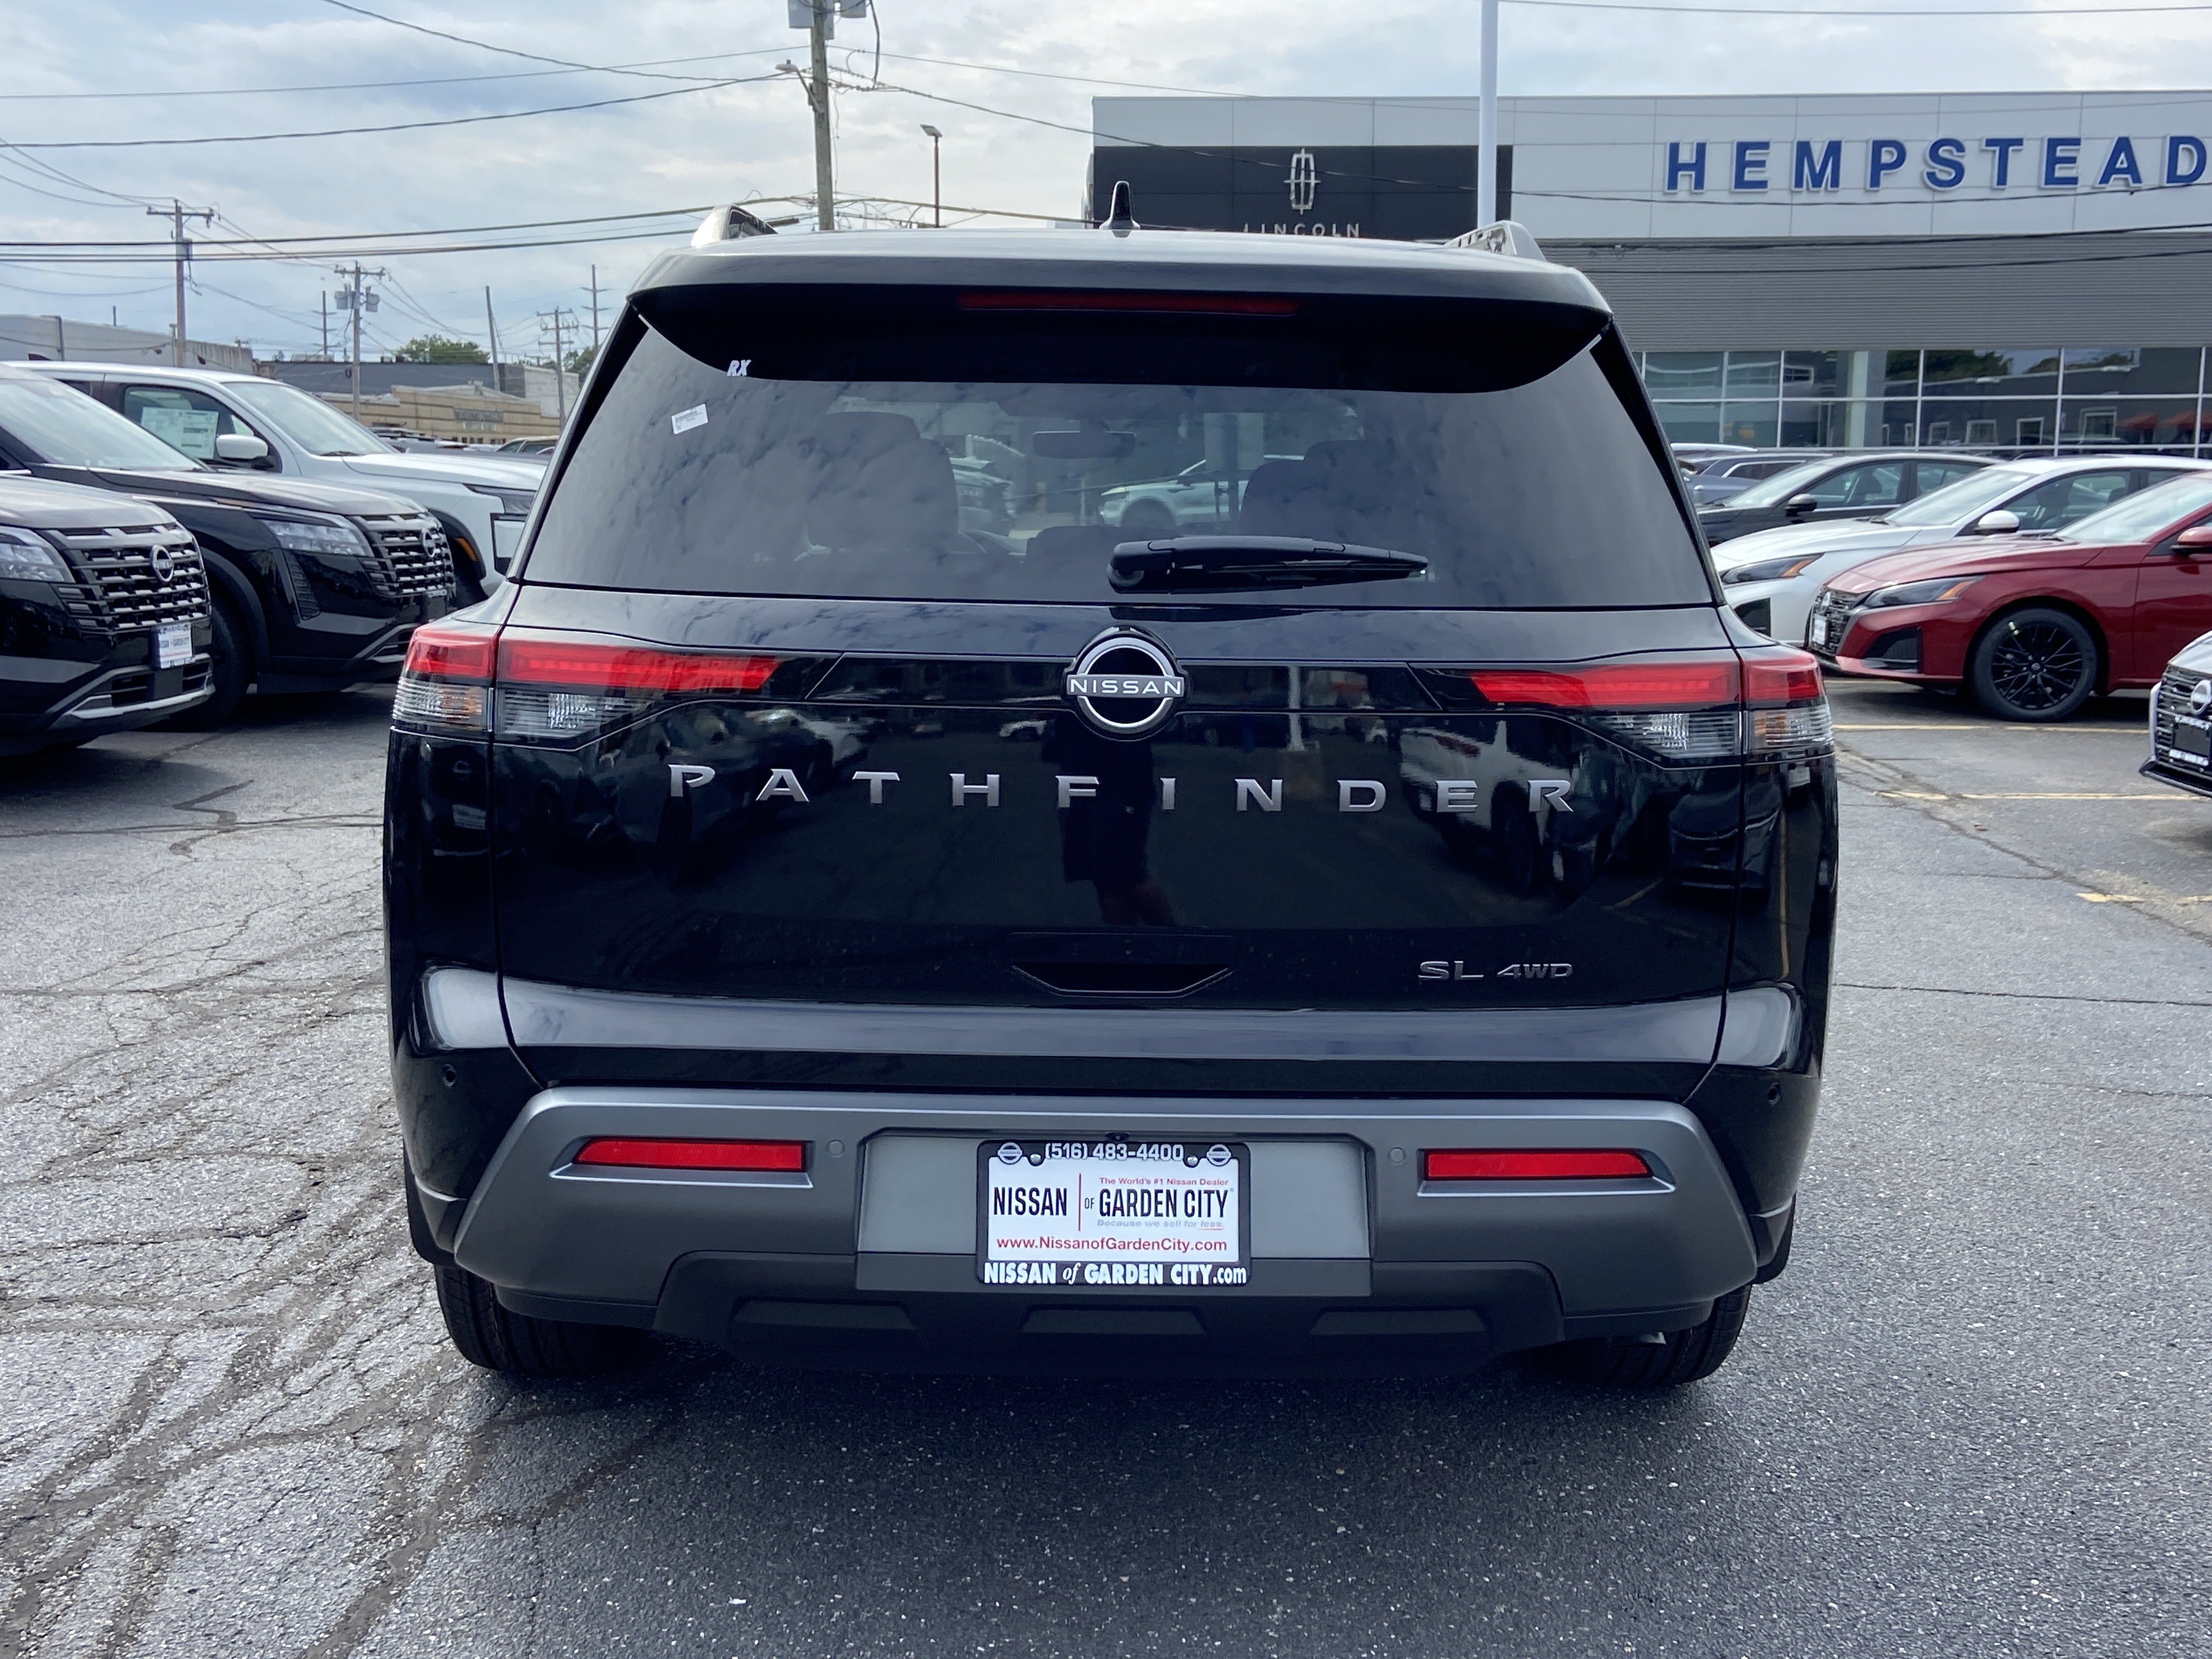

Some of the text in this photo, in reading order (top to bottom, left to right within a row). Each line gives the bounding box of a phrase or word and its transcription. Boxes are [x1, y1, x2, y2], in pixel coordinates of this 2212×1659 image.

[1666, 135, 2208, 192] HEMPSTEAD
[727, 359, 752, 376] RX
[1070, 679, 1181, 695] NISSAN
[668, 764, 1574, 813] PATHFINDER
[1418, 961, 1573, 980] SL 4WD
[1045, 1143, 1184, 1161] (516) 483-4400
[994, 1187, 1228, 1218] NISSAN OF GARDEN CITY
[996, 1236, 1227, 1253] www.NissanofGardenCity.com
[984, 1262, 1247, 1284] NISSAN of GARDEN CITY.com
